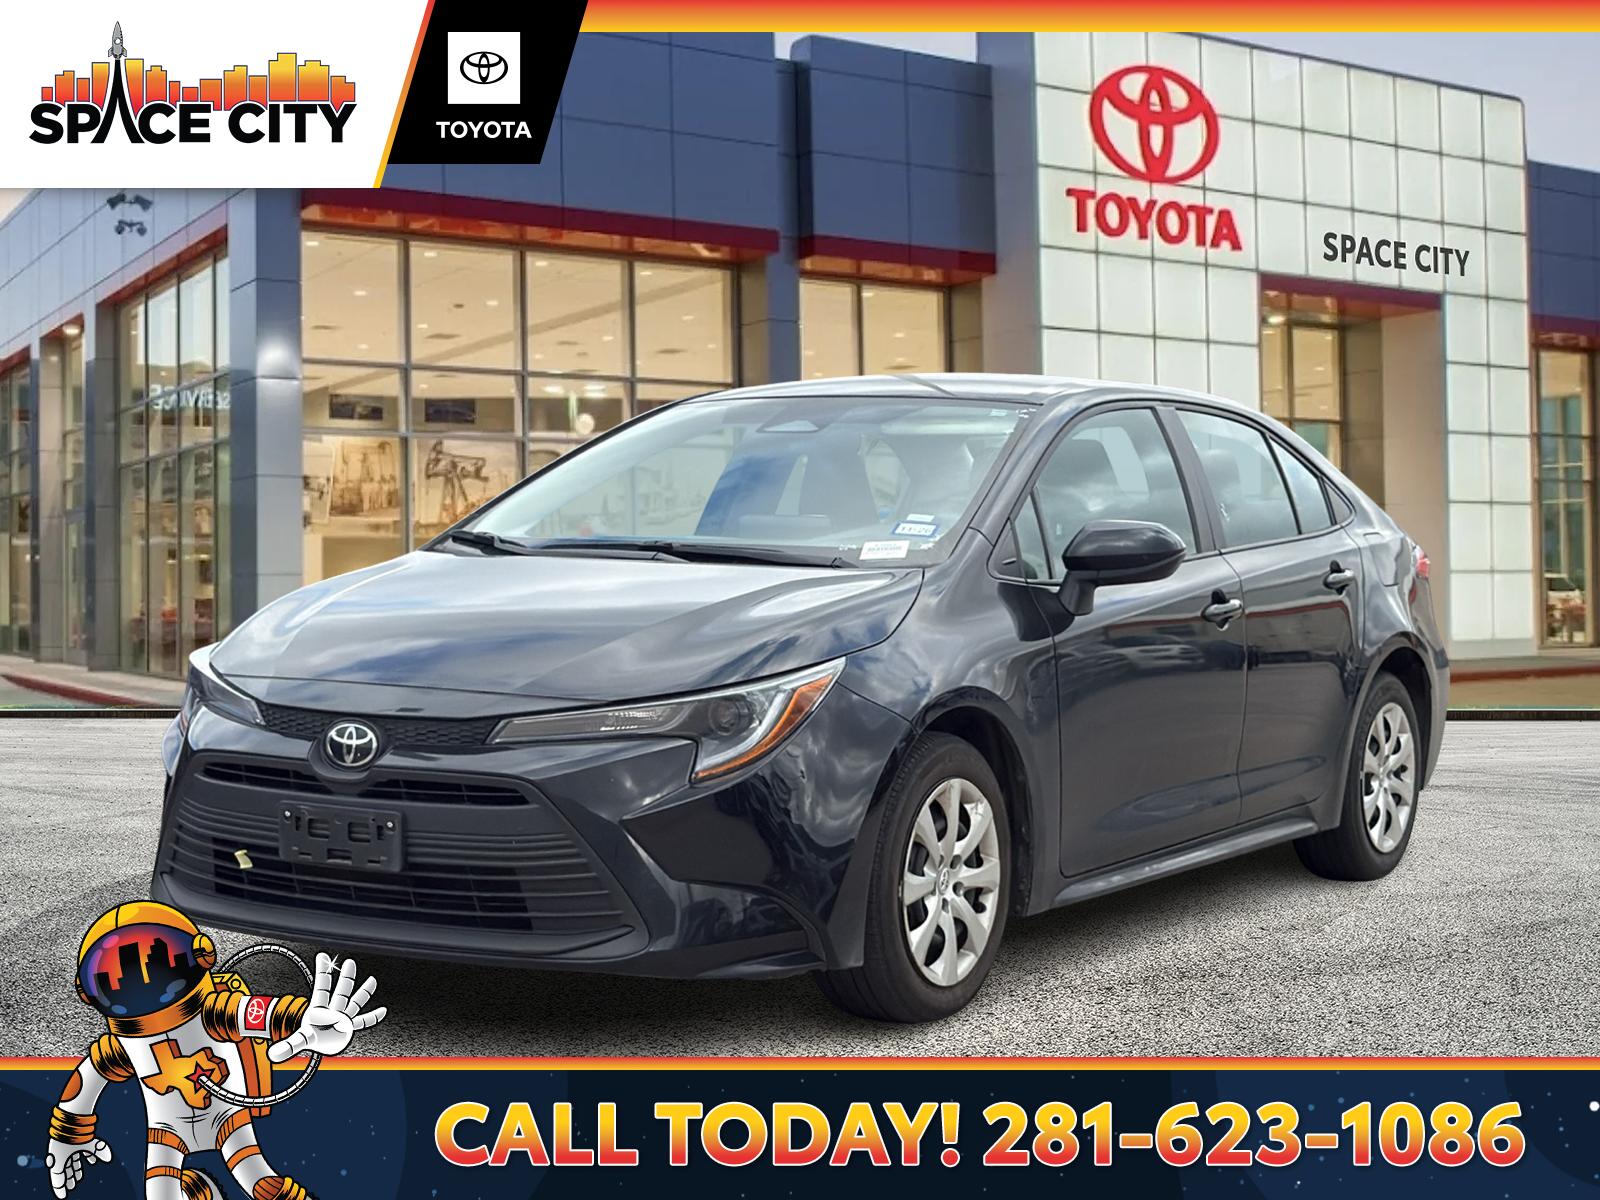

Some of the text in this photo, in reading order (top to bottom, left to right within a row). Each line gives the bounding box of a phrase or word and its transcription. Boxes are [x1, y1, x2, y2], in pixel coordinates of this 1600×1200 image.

[1066, 188, 1242, 251] TOYOTA
[1323, 232, 1470, 277] SPACE CITY
